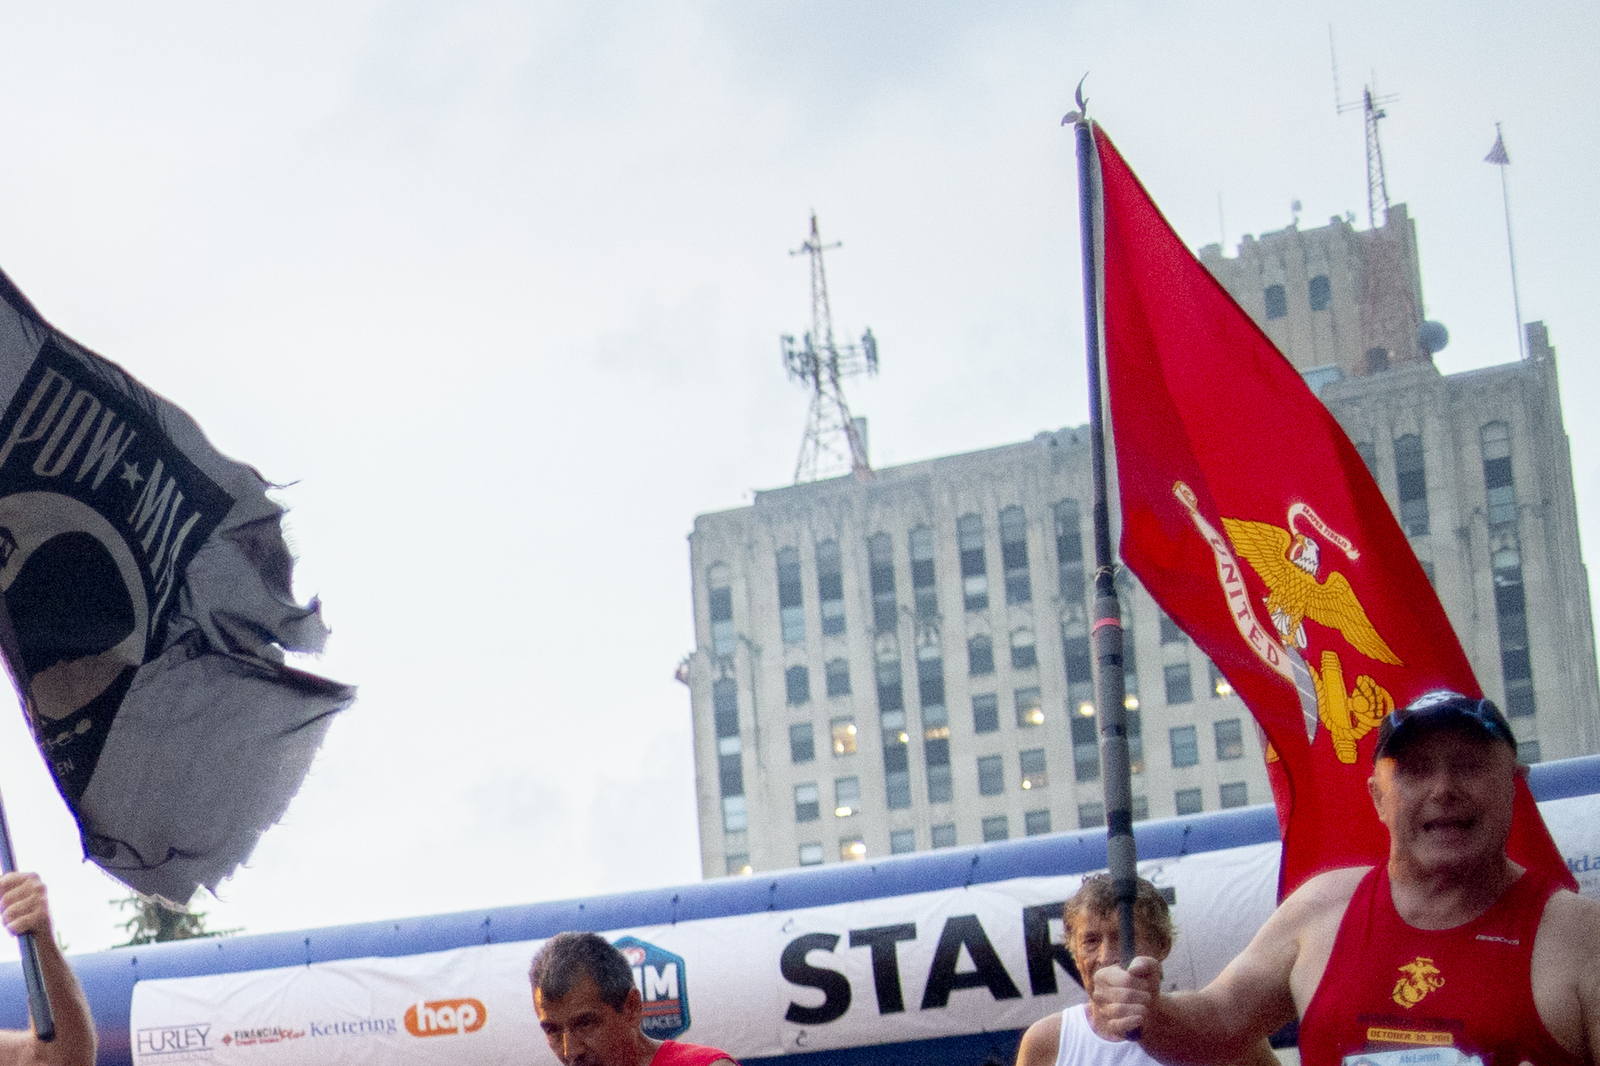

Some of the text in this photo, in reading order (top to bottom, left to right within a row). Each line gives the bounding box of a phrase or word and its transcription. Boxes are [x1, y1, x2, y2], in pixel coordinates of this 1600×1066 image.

[1210, 537, 1280, 667] UNITED
[780, 887, 1176, 1026] STAR
[310, 1017, 398, 1037] Kettering
[416, 1000, 478, 1034] hap
[137, 1026, 212, 1052] HURLEY
